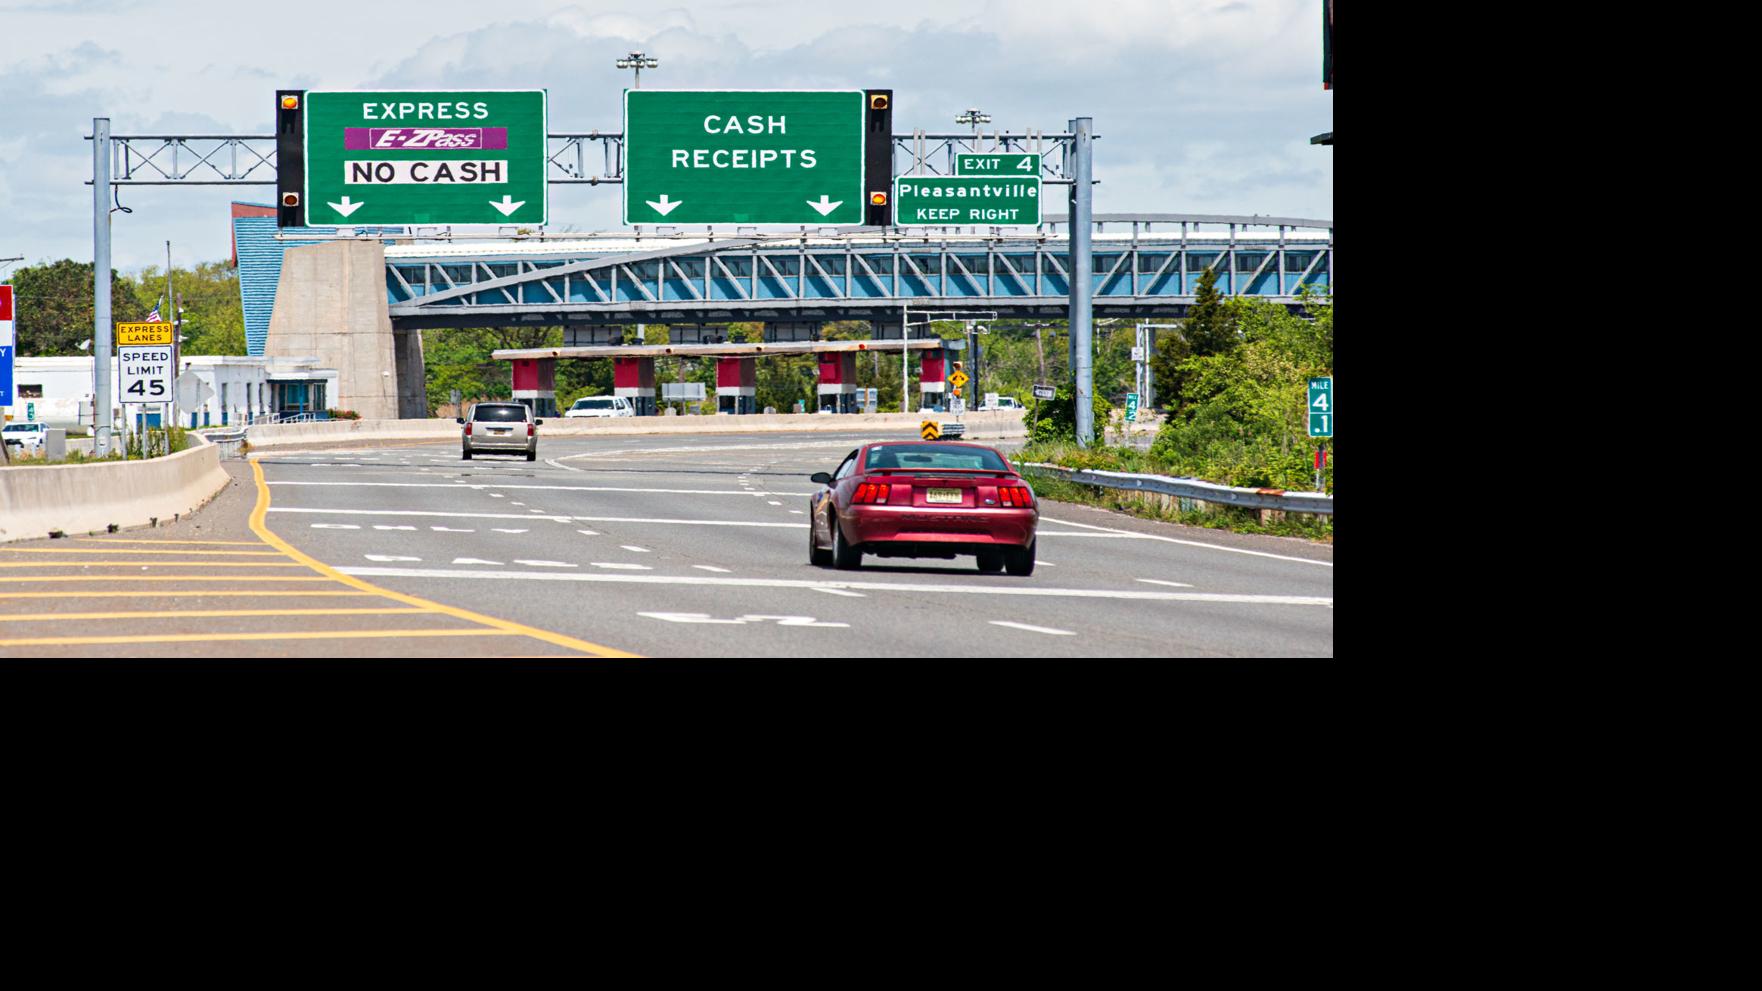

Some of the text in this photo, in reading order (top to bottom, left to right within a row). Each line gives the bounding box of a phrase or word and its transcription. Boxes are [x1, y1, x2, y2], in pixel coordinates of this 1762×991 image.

[363, 102, 489, 120] EXPRESS
[703, 115, 786, 134] CASH
[671, 149, 817, 168] RECEIPTS
[963, 156, 1033, 172] EXIT 4
[352, 162, 501, 182] NO CASH
[899, 184, 1038, 197] Pleasantville
[916, 208, 1020, 220] KEEP RIGHT
[120, 325, 169, 334] EXPRESS
[127, 334, 162, 342] LANES
[122, 352, 169, 362] SPEED
[127, 365, 164, 375] LIMIT
[127, 379, 165, 396] 45
[1311, 381, 1329, 390] MILE
[1312, 393, 1329, 412] 4
